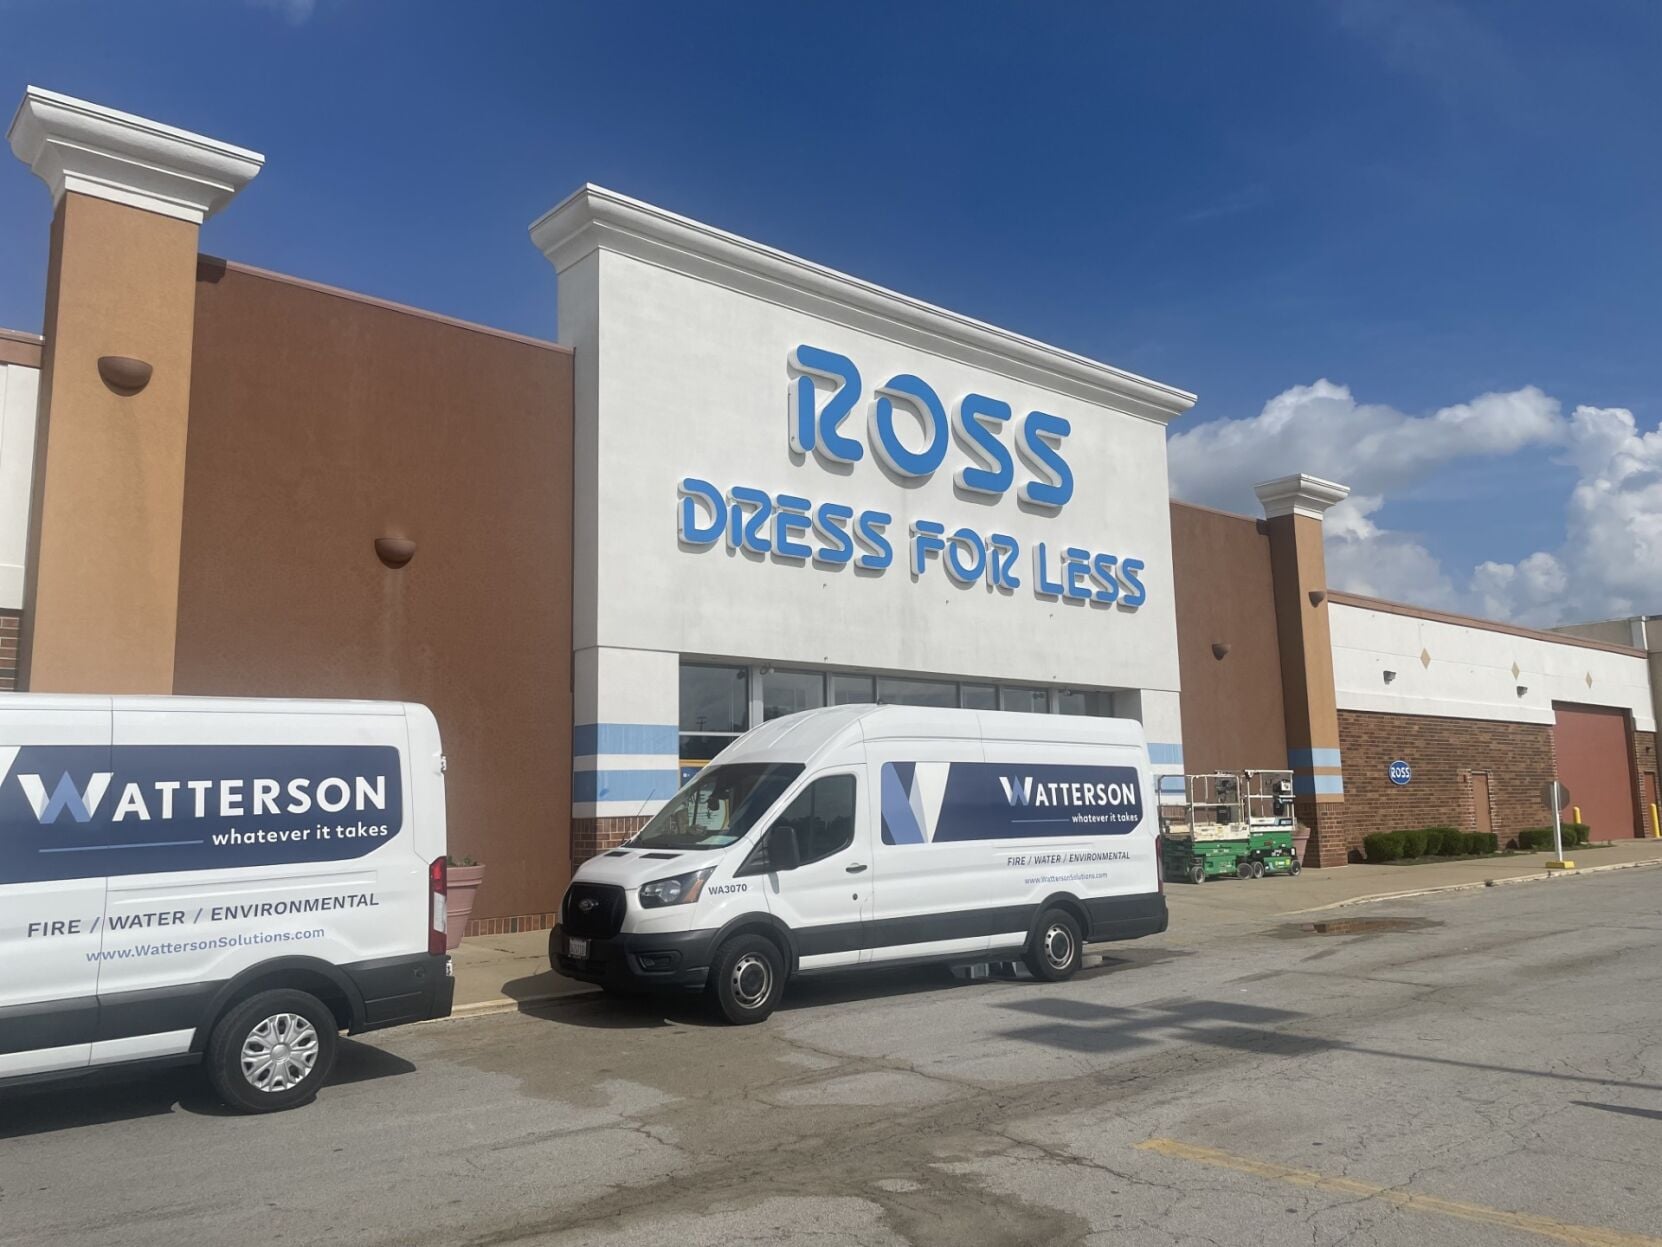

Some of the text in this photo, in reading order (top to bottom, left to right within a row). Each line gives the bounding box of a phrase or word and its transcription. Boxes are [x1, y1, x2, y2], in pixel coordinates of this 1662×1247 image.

[789, 345, 1074, 506] ROSS
[679, 478, 1146, 607] DRESS FOR LESS
[1391, 767, 1410, 778] ROSS
[18, 772, 386, 824] WATTERSON
[999, 776, 1135, 806] WATTERSON
[1072, 812, 1138, 823] whatever it takes
[212, 822, 389, 846] whatever it takes
[1007, 856, 1026, 866] FIRE
[1034, 854, 1062, 865] WATER
[1069, 852, 1131, 863] ENVIRONMENTAL
[708, 884, 747, 895] WA3070
[27, 919, 81, 938] FIRE
[108, 910, 186, 932] WATER
[210, 893, 380, 921] ENVIRONMENTAL
[86, 928, 325, 962] www.WattersonSolutions.com
